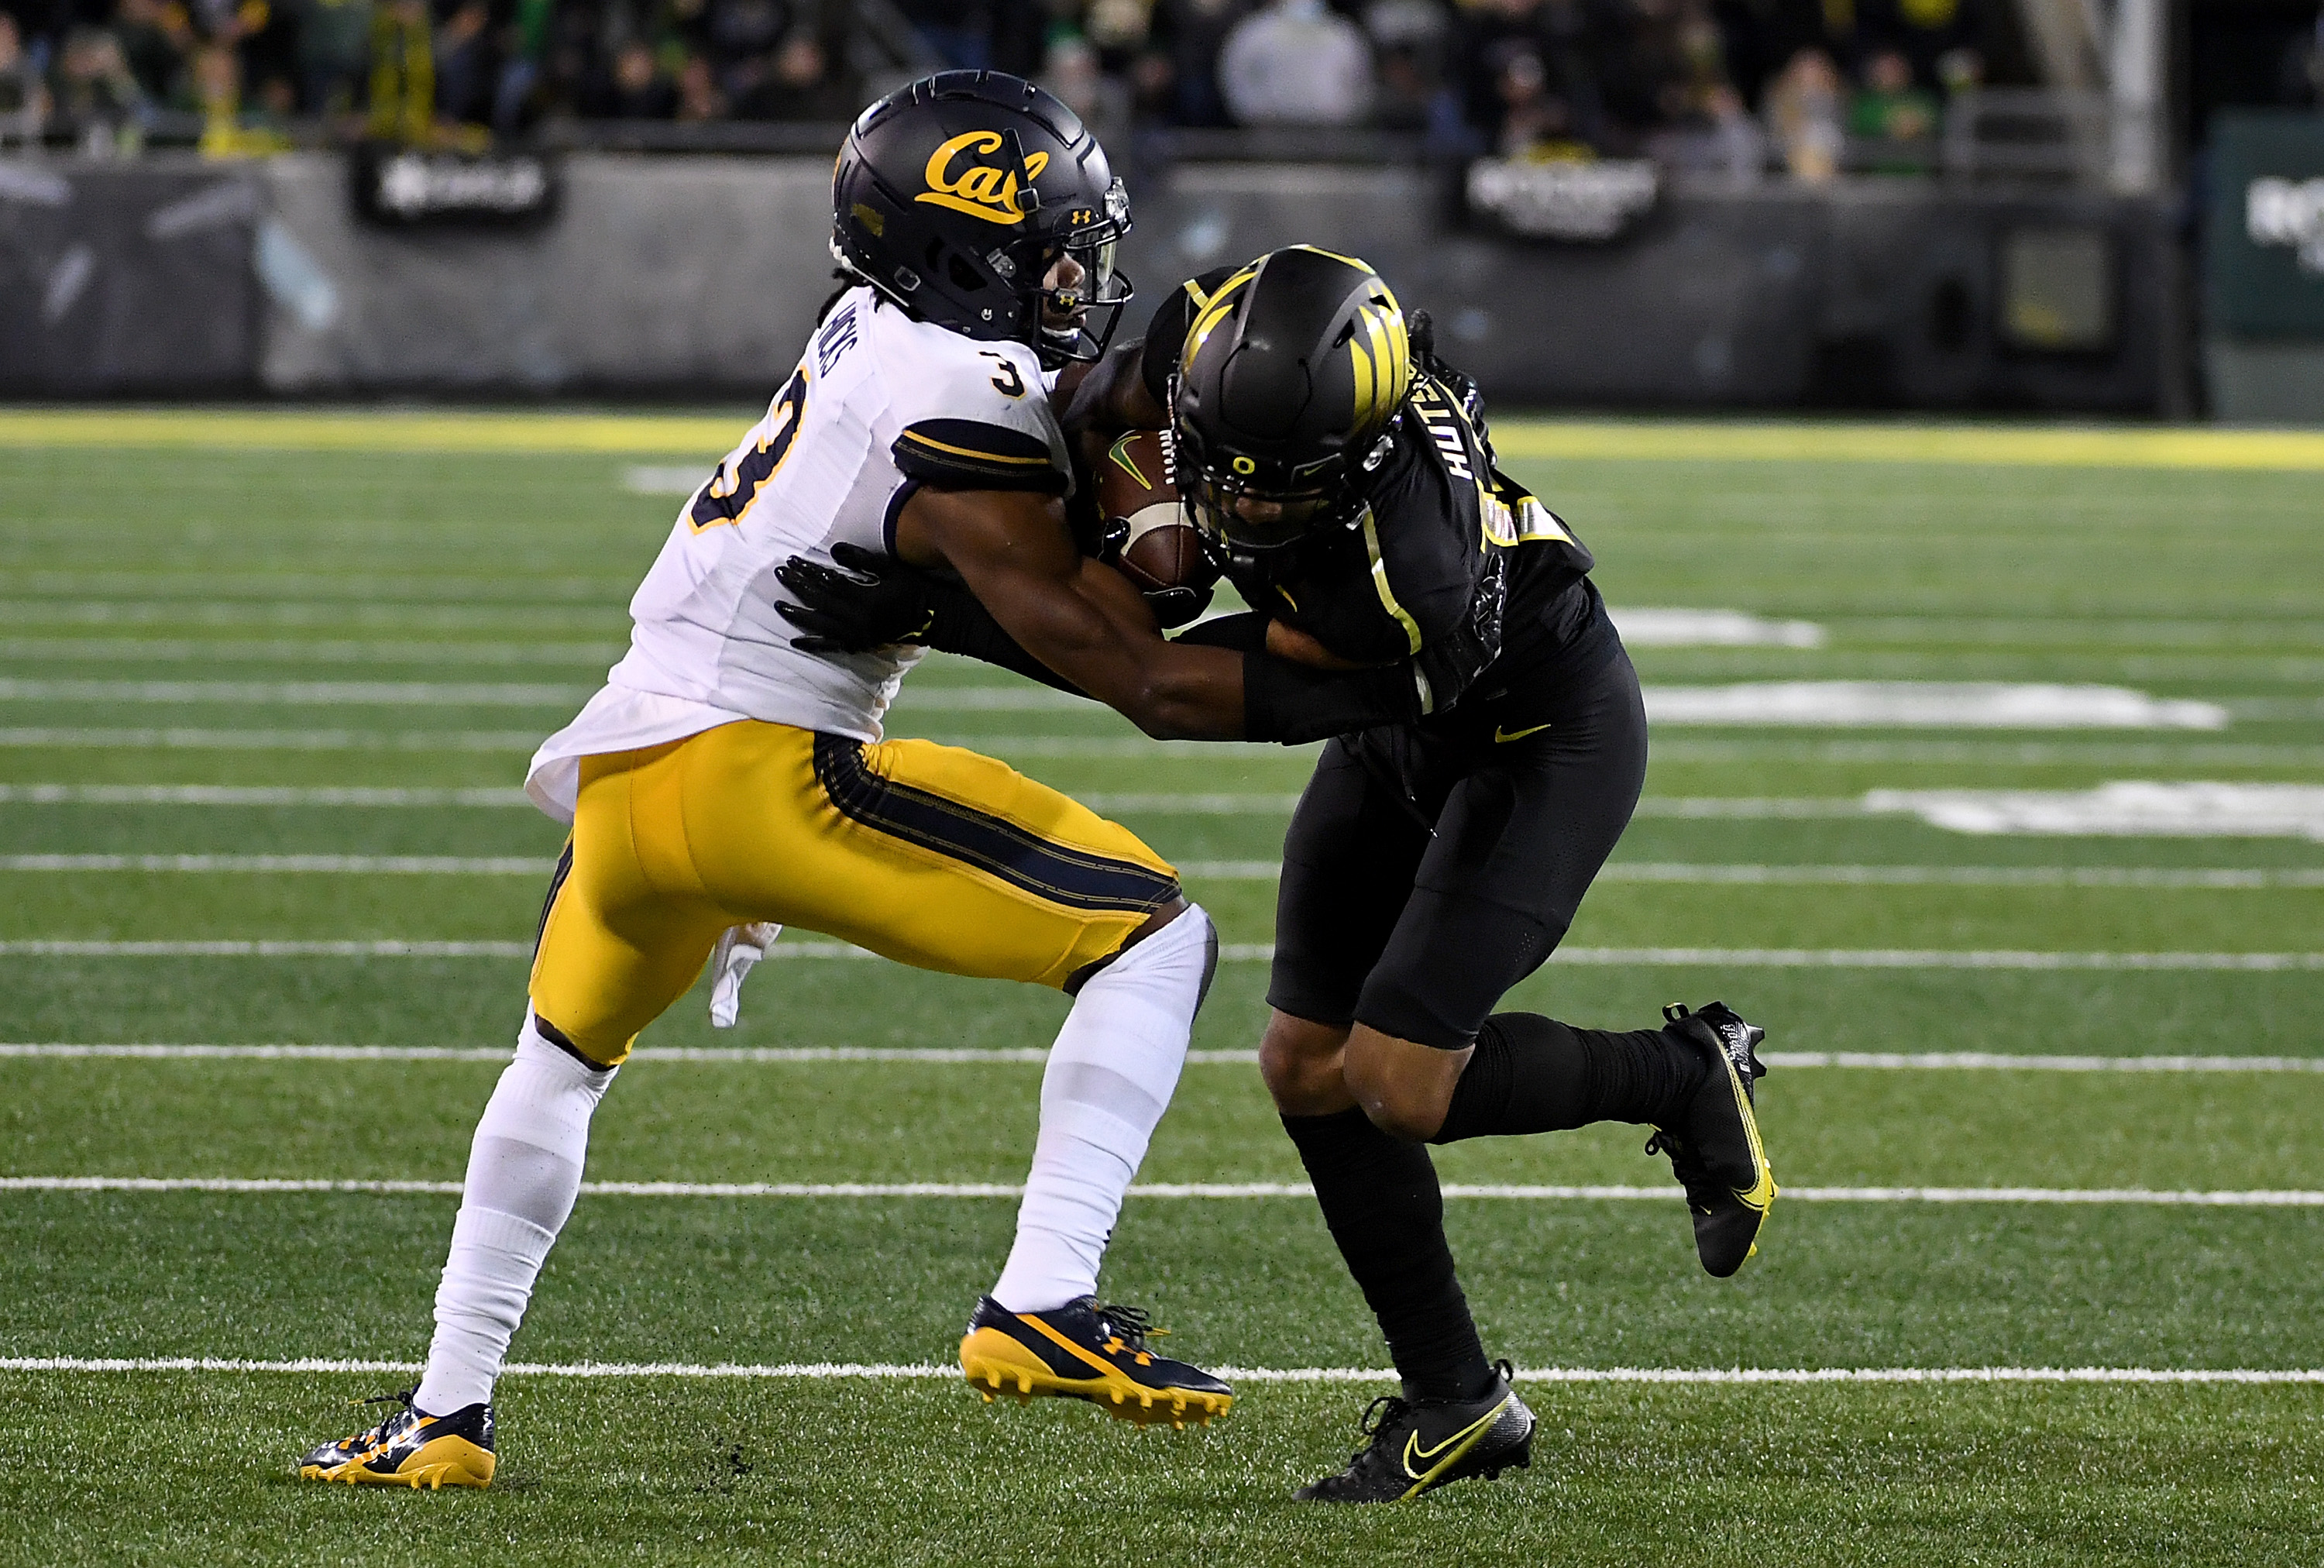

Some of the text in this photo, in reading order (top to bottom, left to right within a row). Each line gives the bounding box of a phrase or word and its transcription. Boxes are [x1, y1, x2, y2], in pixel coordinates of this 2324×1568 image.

[914, 130, 1049, 225] Cal
[978, 350, 1026, 400] 3
[687, 366, 811, 535] 3
